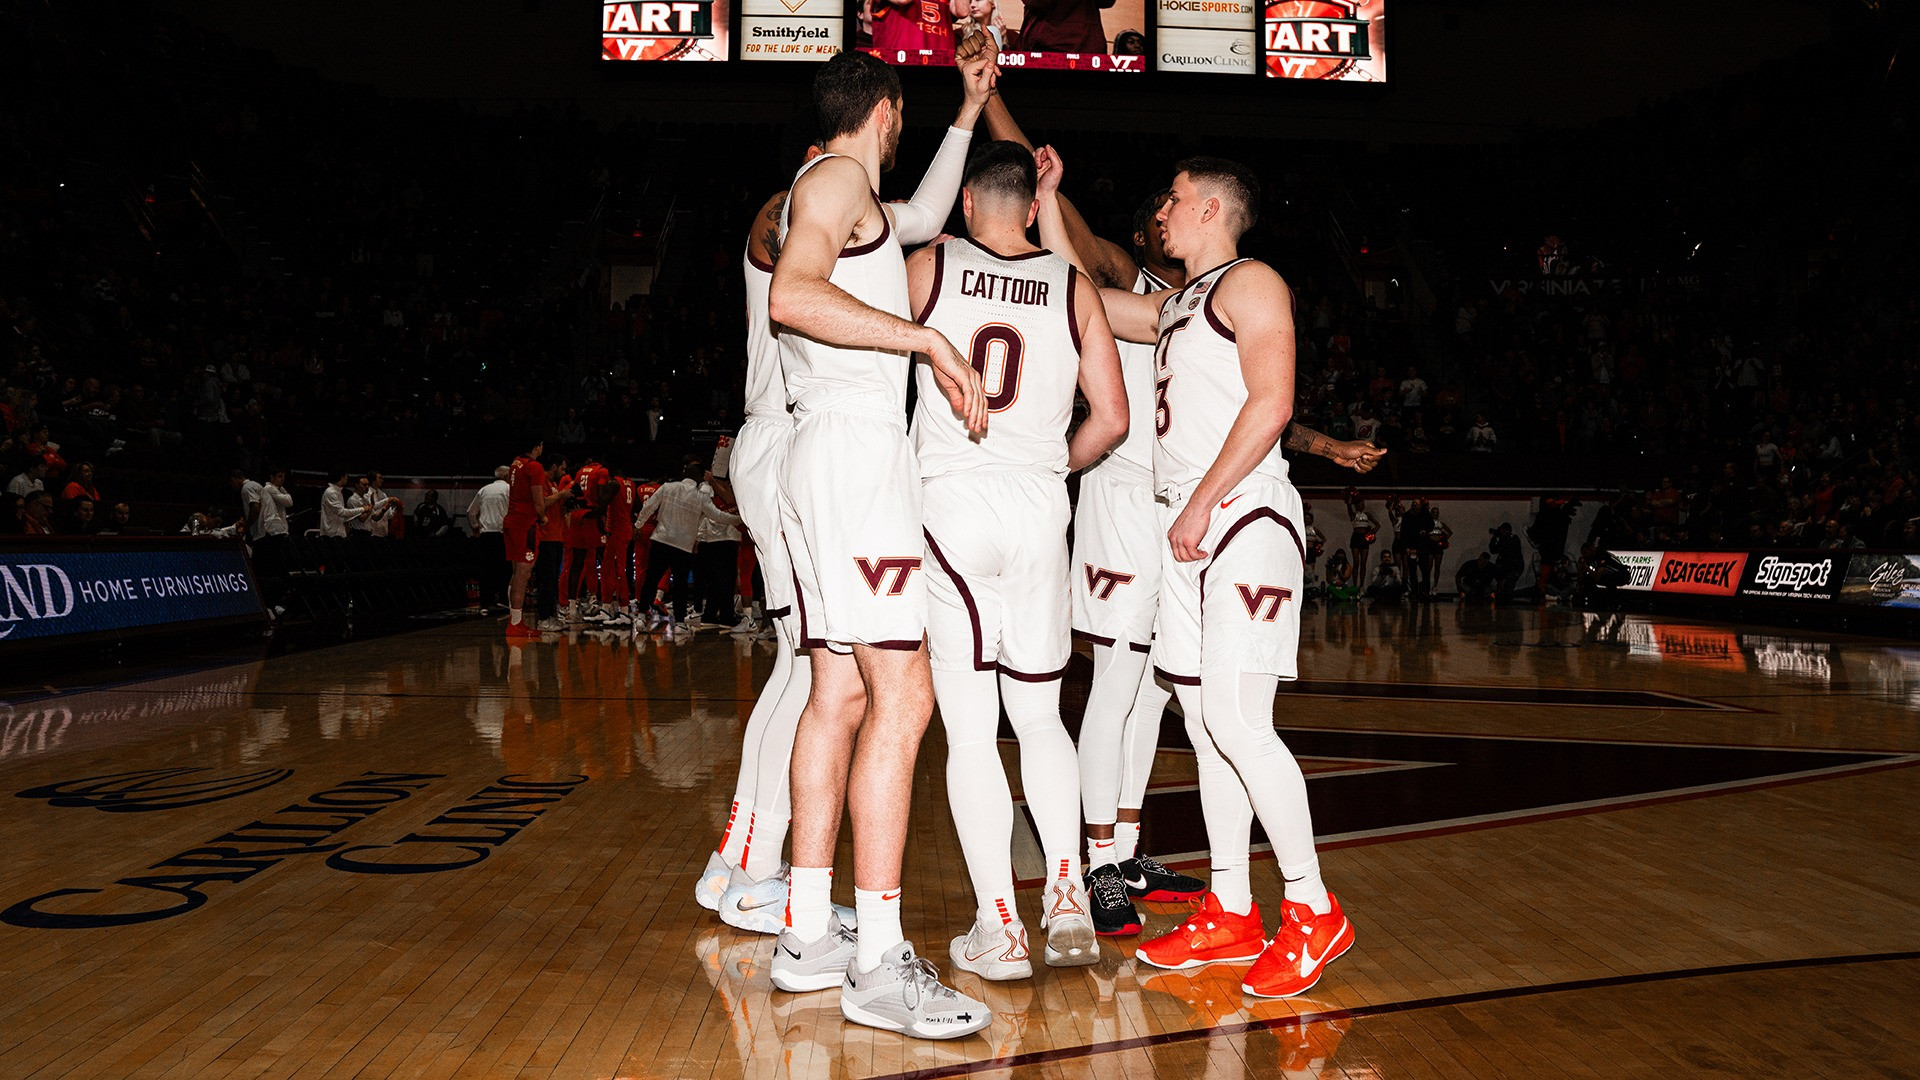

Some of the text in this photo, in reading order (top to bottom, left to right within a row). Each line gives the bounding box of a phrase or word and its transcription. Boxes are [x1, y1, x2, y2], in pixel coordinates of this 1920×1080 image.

[916, 22, 947, 37] TECH
[921, 1, 941, 23] 5
[745, 44, 837, 54] FOR THE LOVE OF MEAT
[752, 26, 829, 42] Smithfield
[897, 50, 906, 63] 0
[1091, 56, 1101, 68] 0
[1109, 55, 1139, 69] VT
[960, 269, 1050, 307] CATTOOR
[1154, 313, 1195, 372] T
[968, 322, 1026, 414] 0
[853, 556, 923, 596] VT
[1084, 562, 1136, 602] VT
[1660, 559, 1738, 588] SEATGEEK
[1754, 555, 1832, 591] Signspot
[0, 563, 248, 622] ND HOME FURNISHINGS
[1233, 583, 1294, 623] VT
[325, 773, 590, 875] CLINIC
[0, 770, 446, 929] CARILION
